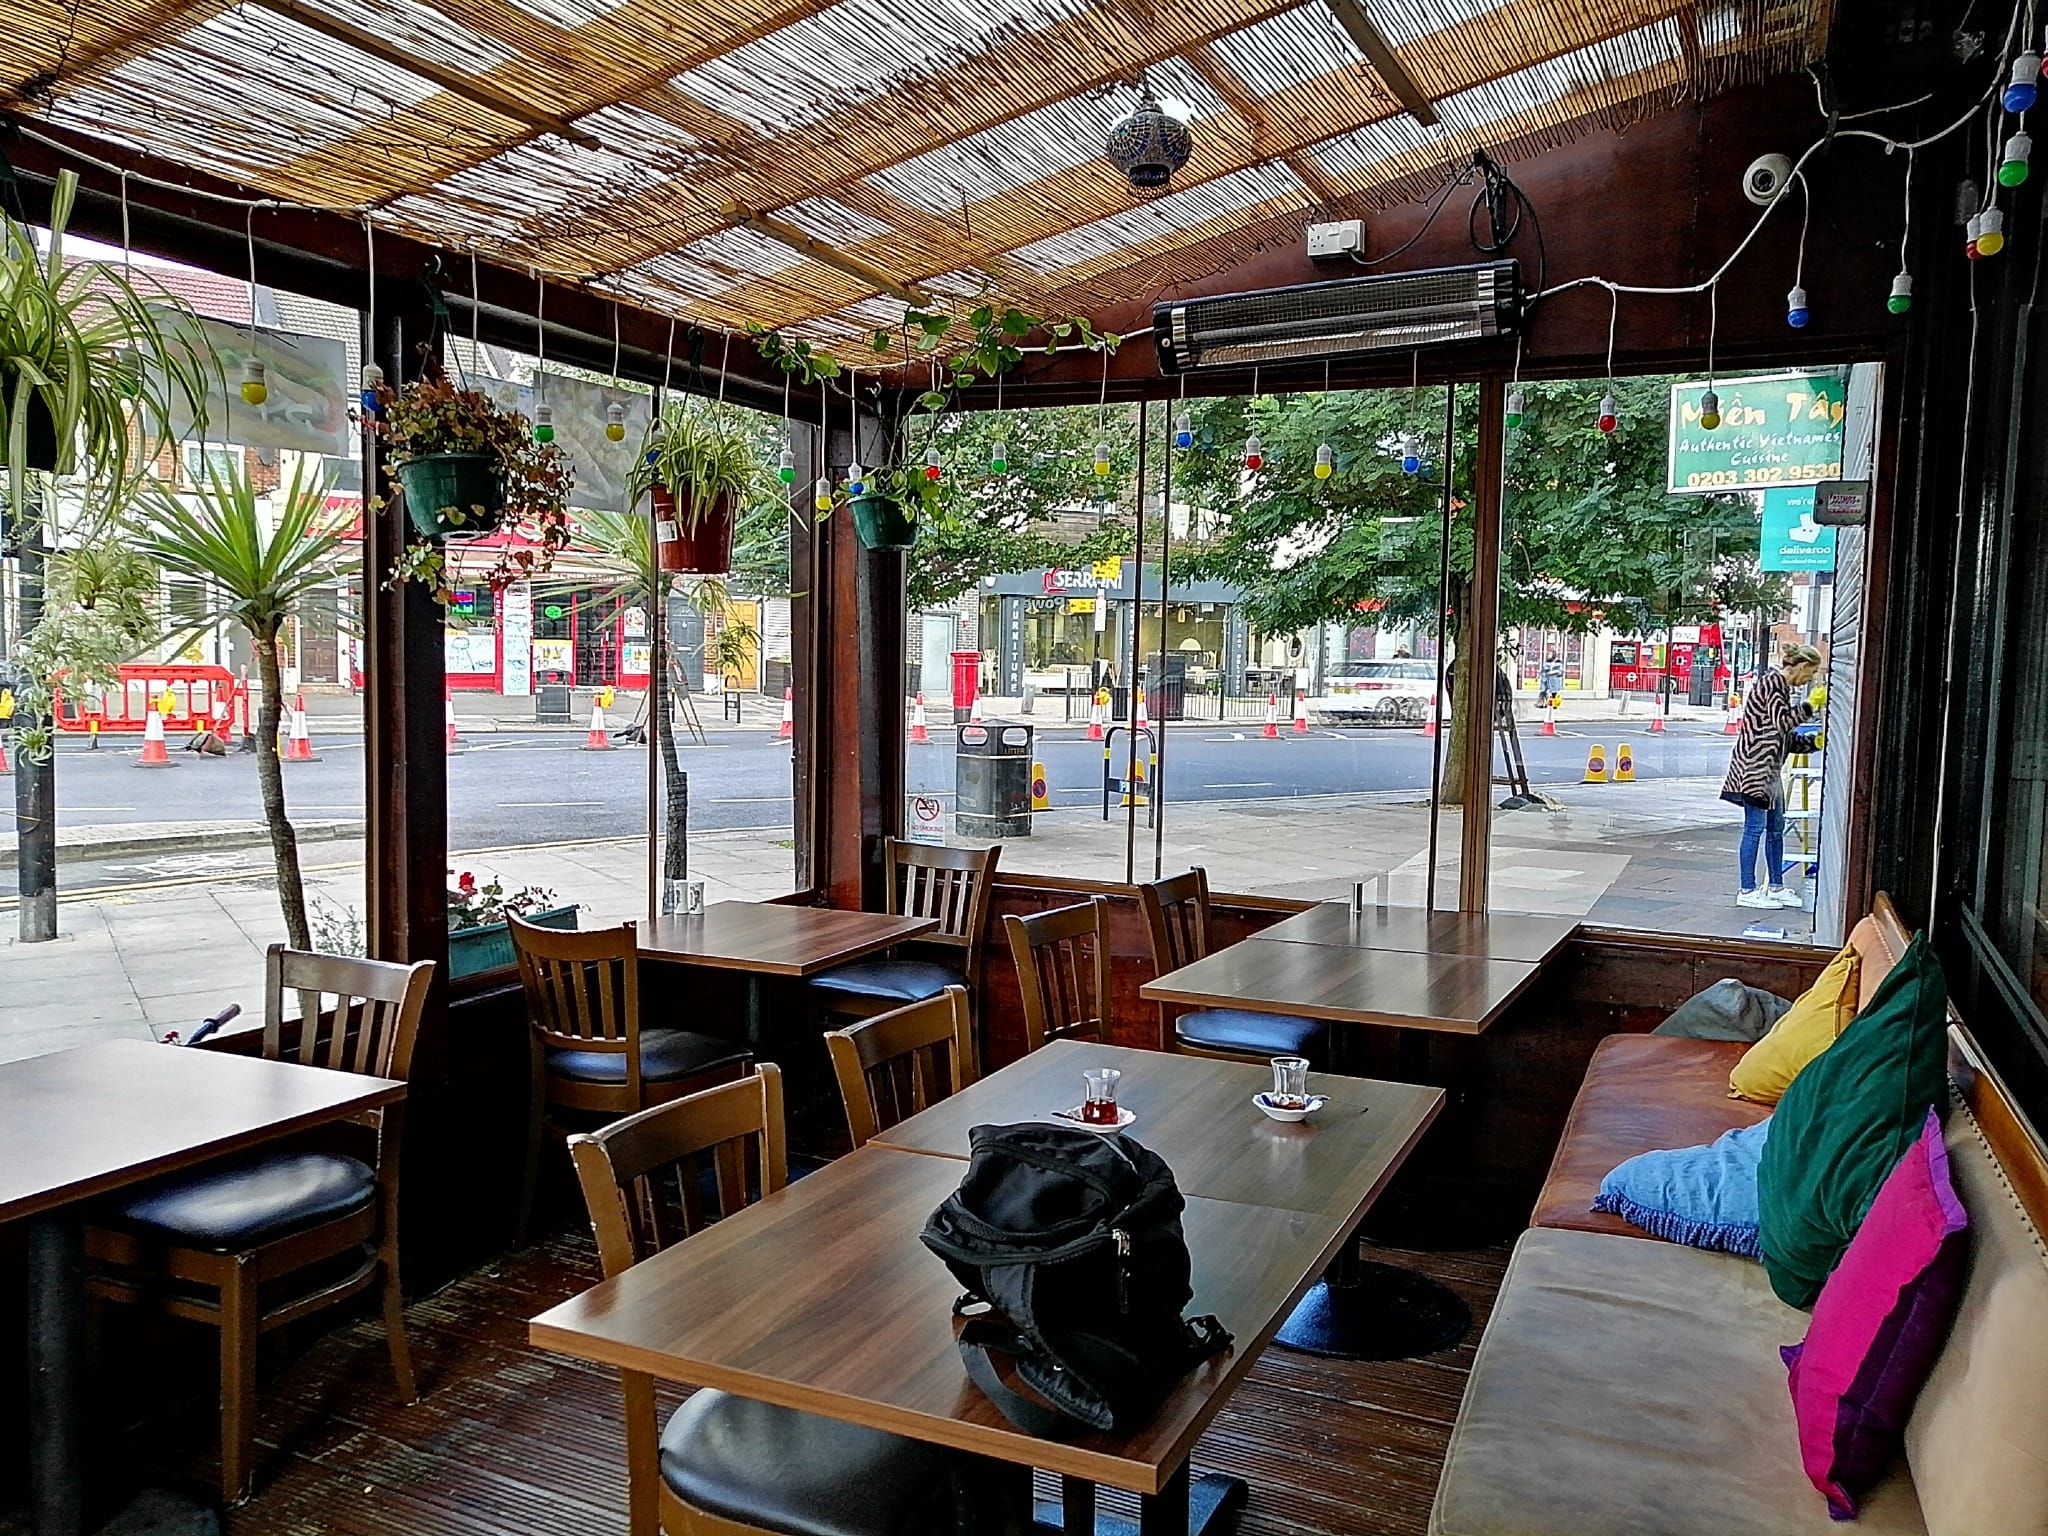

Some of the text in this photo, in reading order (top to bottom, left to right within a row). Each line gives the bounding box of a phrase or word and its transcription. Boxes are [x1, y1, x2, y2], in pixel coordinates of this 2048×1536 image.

[1679, 436, 1752, 453] Authentic
[1731, 450, 1789, 466] Cuisine
[1687, 462, 1840, 487] 0203 302 9530
[1779, 545, 1831, 555] deliveroo
[1011, 600, 1019, 692] FURNITURE
[1004, 747, 1025, 755] LITTER
